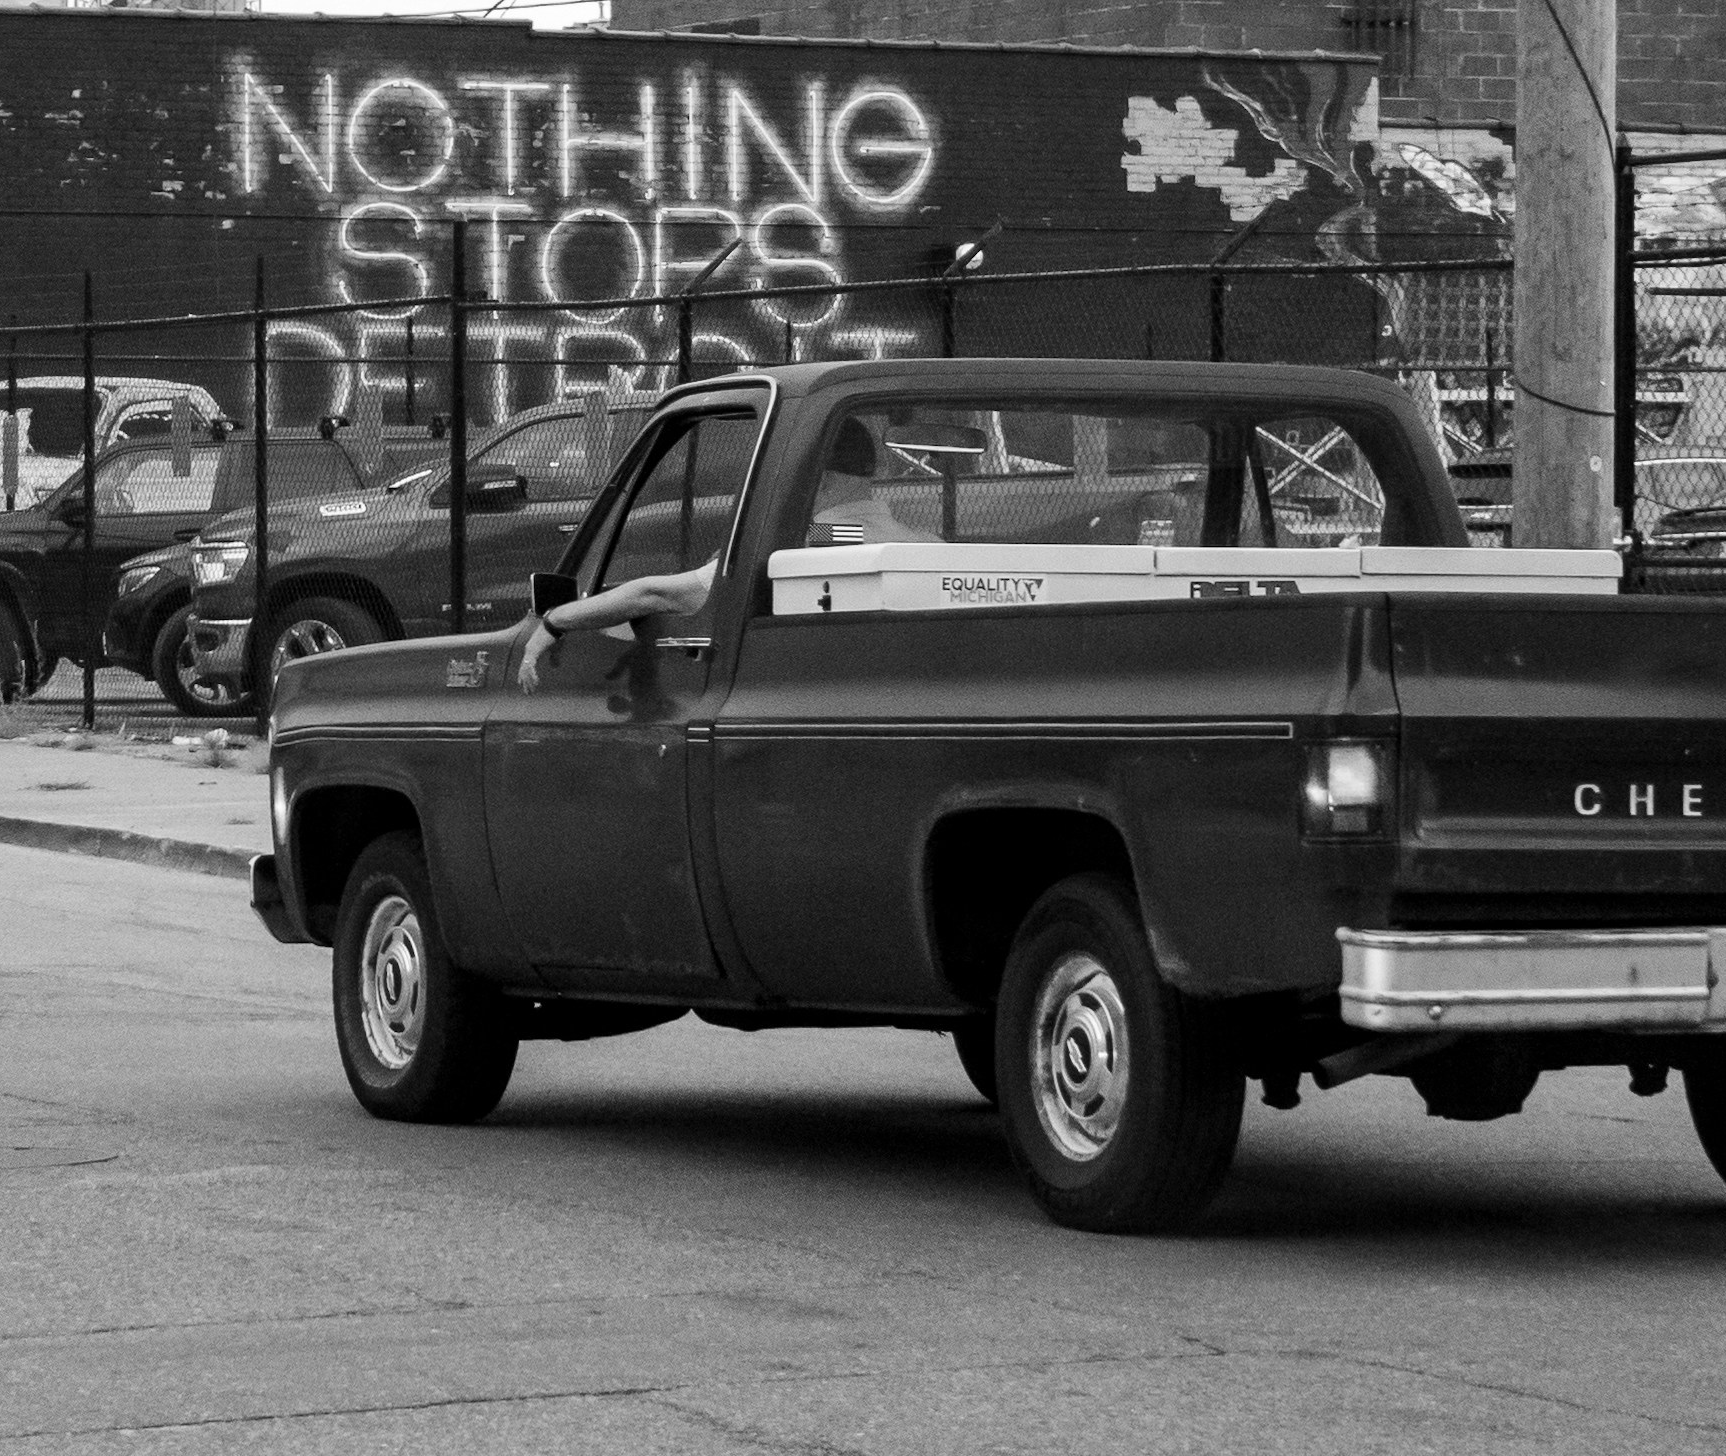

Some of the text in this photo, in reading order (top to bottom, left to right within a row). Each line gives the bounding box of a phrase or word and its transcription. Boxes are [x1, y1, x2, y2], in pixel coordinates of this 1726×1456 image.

[238, 67, 937, 206] NOTHING
[332, 198, 846, 328] STOPS
[260, 322, 920, 430] DETRO
[941, 577, 1022, 592] EQUALITY
[949, 589, 1028, 604] MICHIGAN
